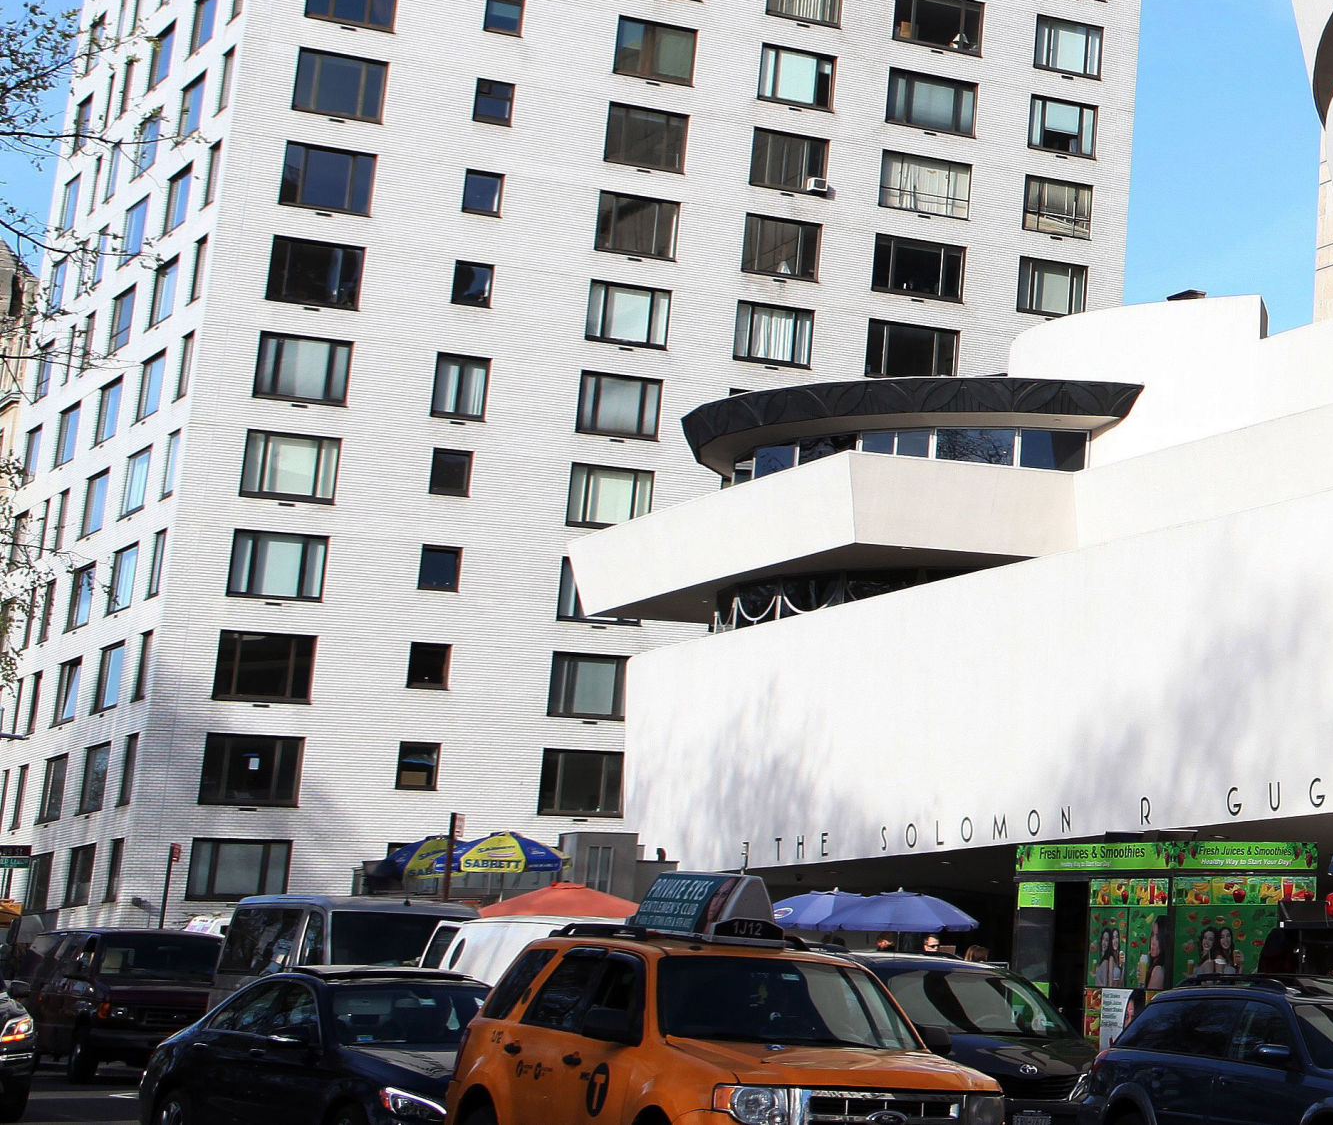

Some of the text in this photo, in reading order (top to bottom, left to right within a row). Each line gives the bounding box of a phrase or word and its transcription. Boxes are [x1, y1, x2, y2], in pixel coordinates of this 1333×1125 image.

[775, 832, 829, 861] THE
[881, 805, 1072, 851] SOLOMON
[1140, 796, 1152, 825] R
[1039, 844, 1145, 859] Fresh Juices & Smoothies
[1198, 845, 1292, 855] Fresh Juices & Smoothies
[464, 859, 522, 869] SABRETT
[1201, 858, 1224, 866] Healthy
[1226, 858, 1238, 866] Way
[646, 878, 714, 901] PRIVATE EYES
[680, 903, 699, 916] CLUB
[733, 920, 762, 936] 1J12
